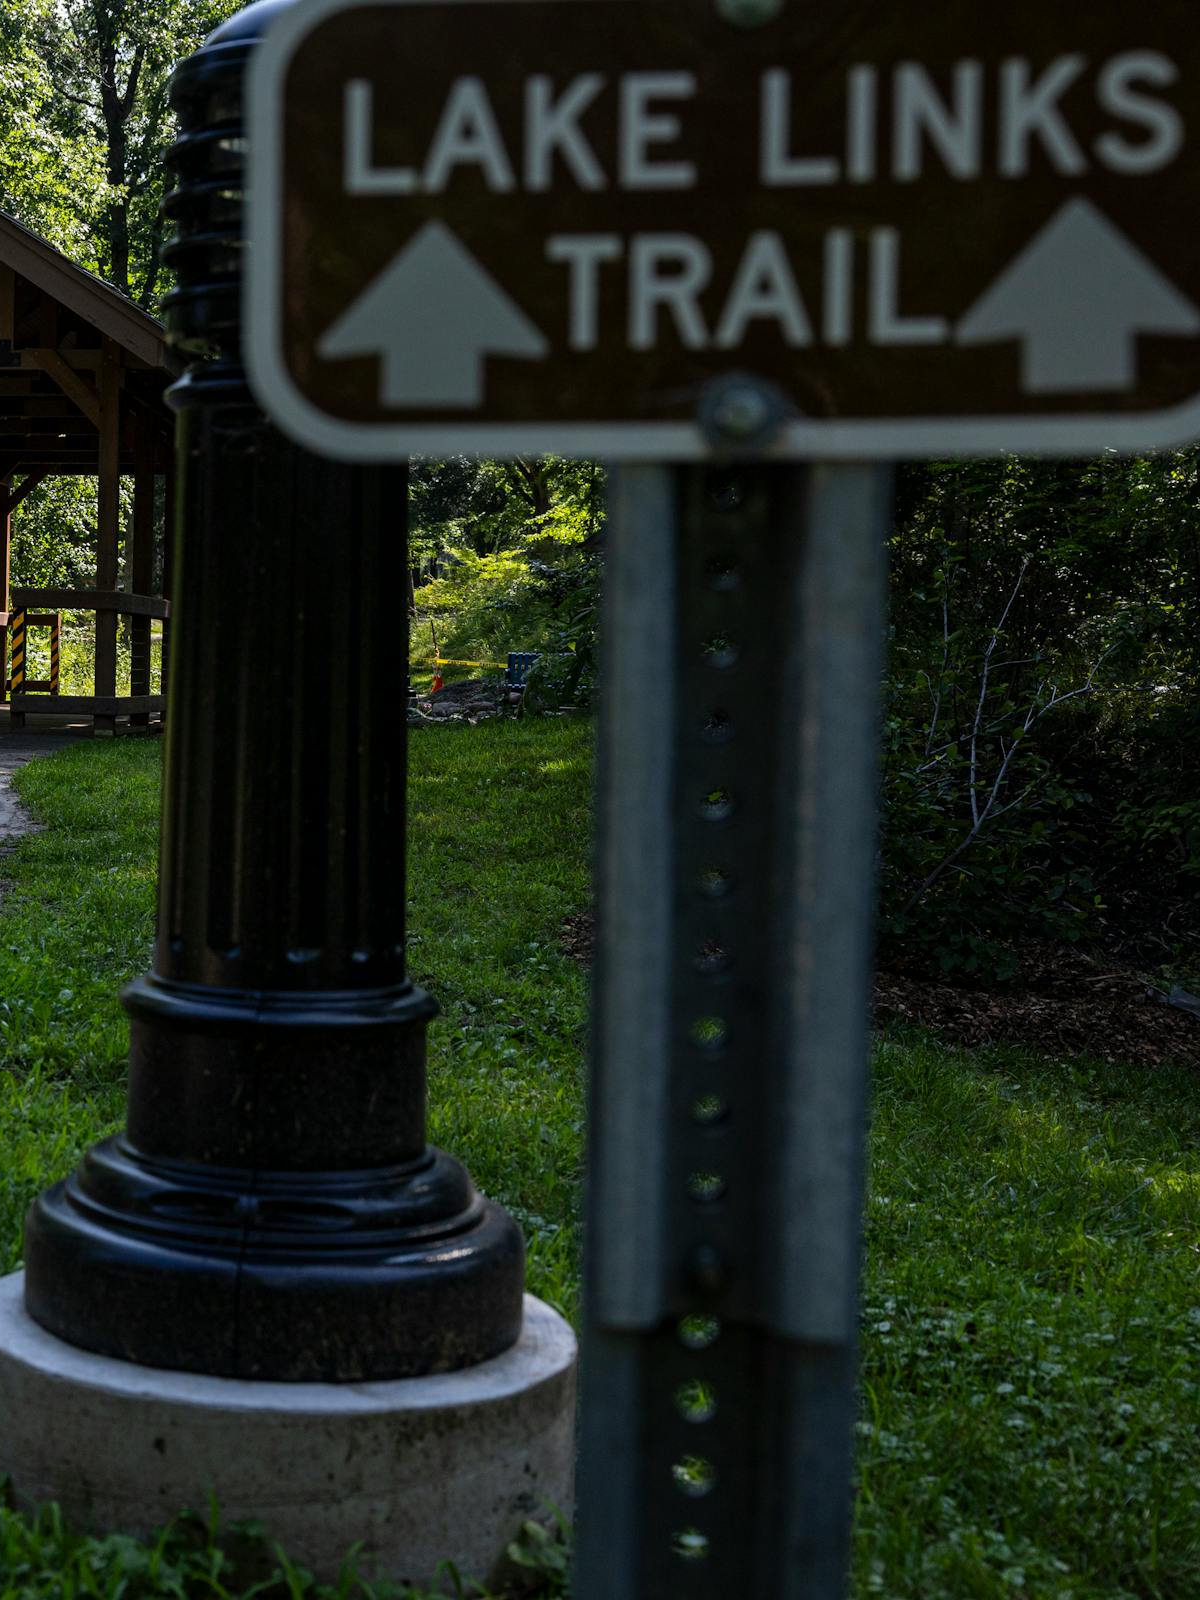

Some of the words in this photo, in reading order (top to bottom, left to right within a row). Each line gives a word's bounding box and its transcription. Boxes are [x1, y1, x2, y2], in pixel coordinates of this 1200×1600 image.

[344, 73, 697, 193] LAKE
[762, 52, 1182, 186] LINKS
[547, 229, 949, 348] TRAIL
